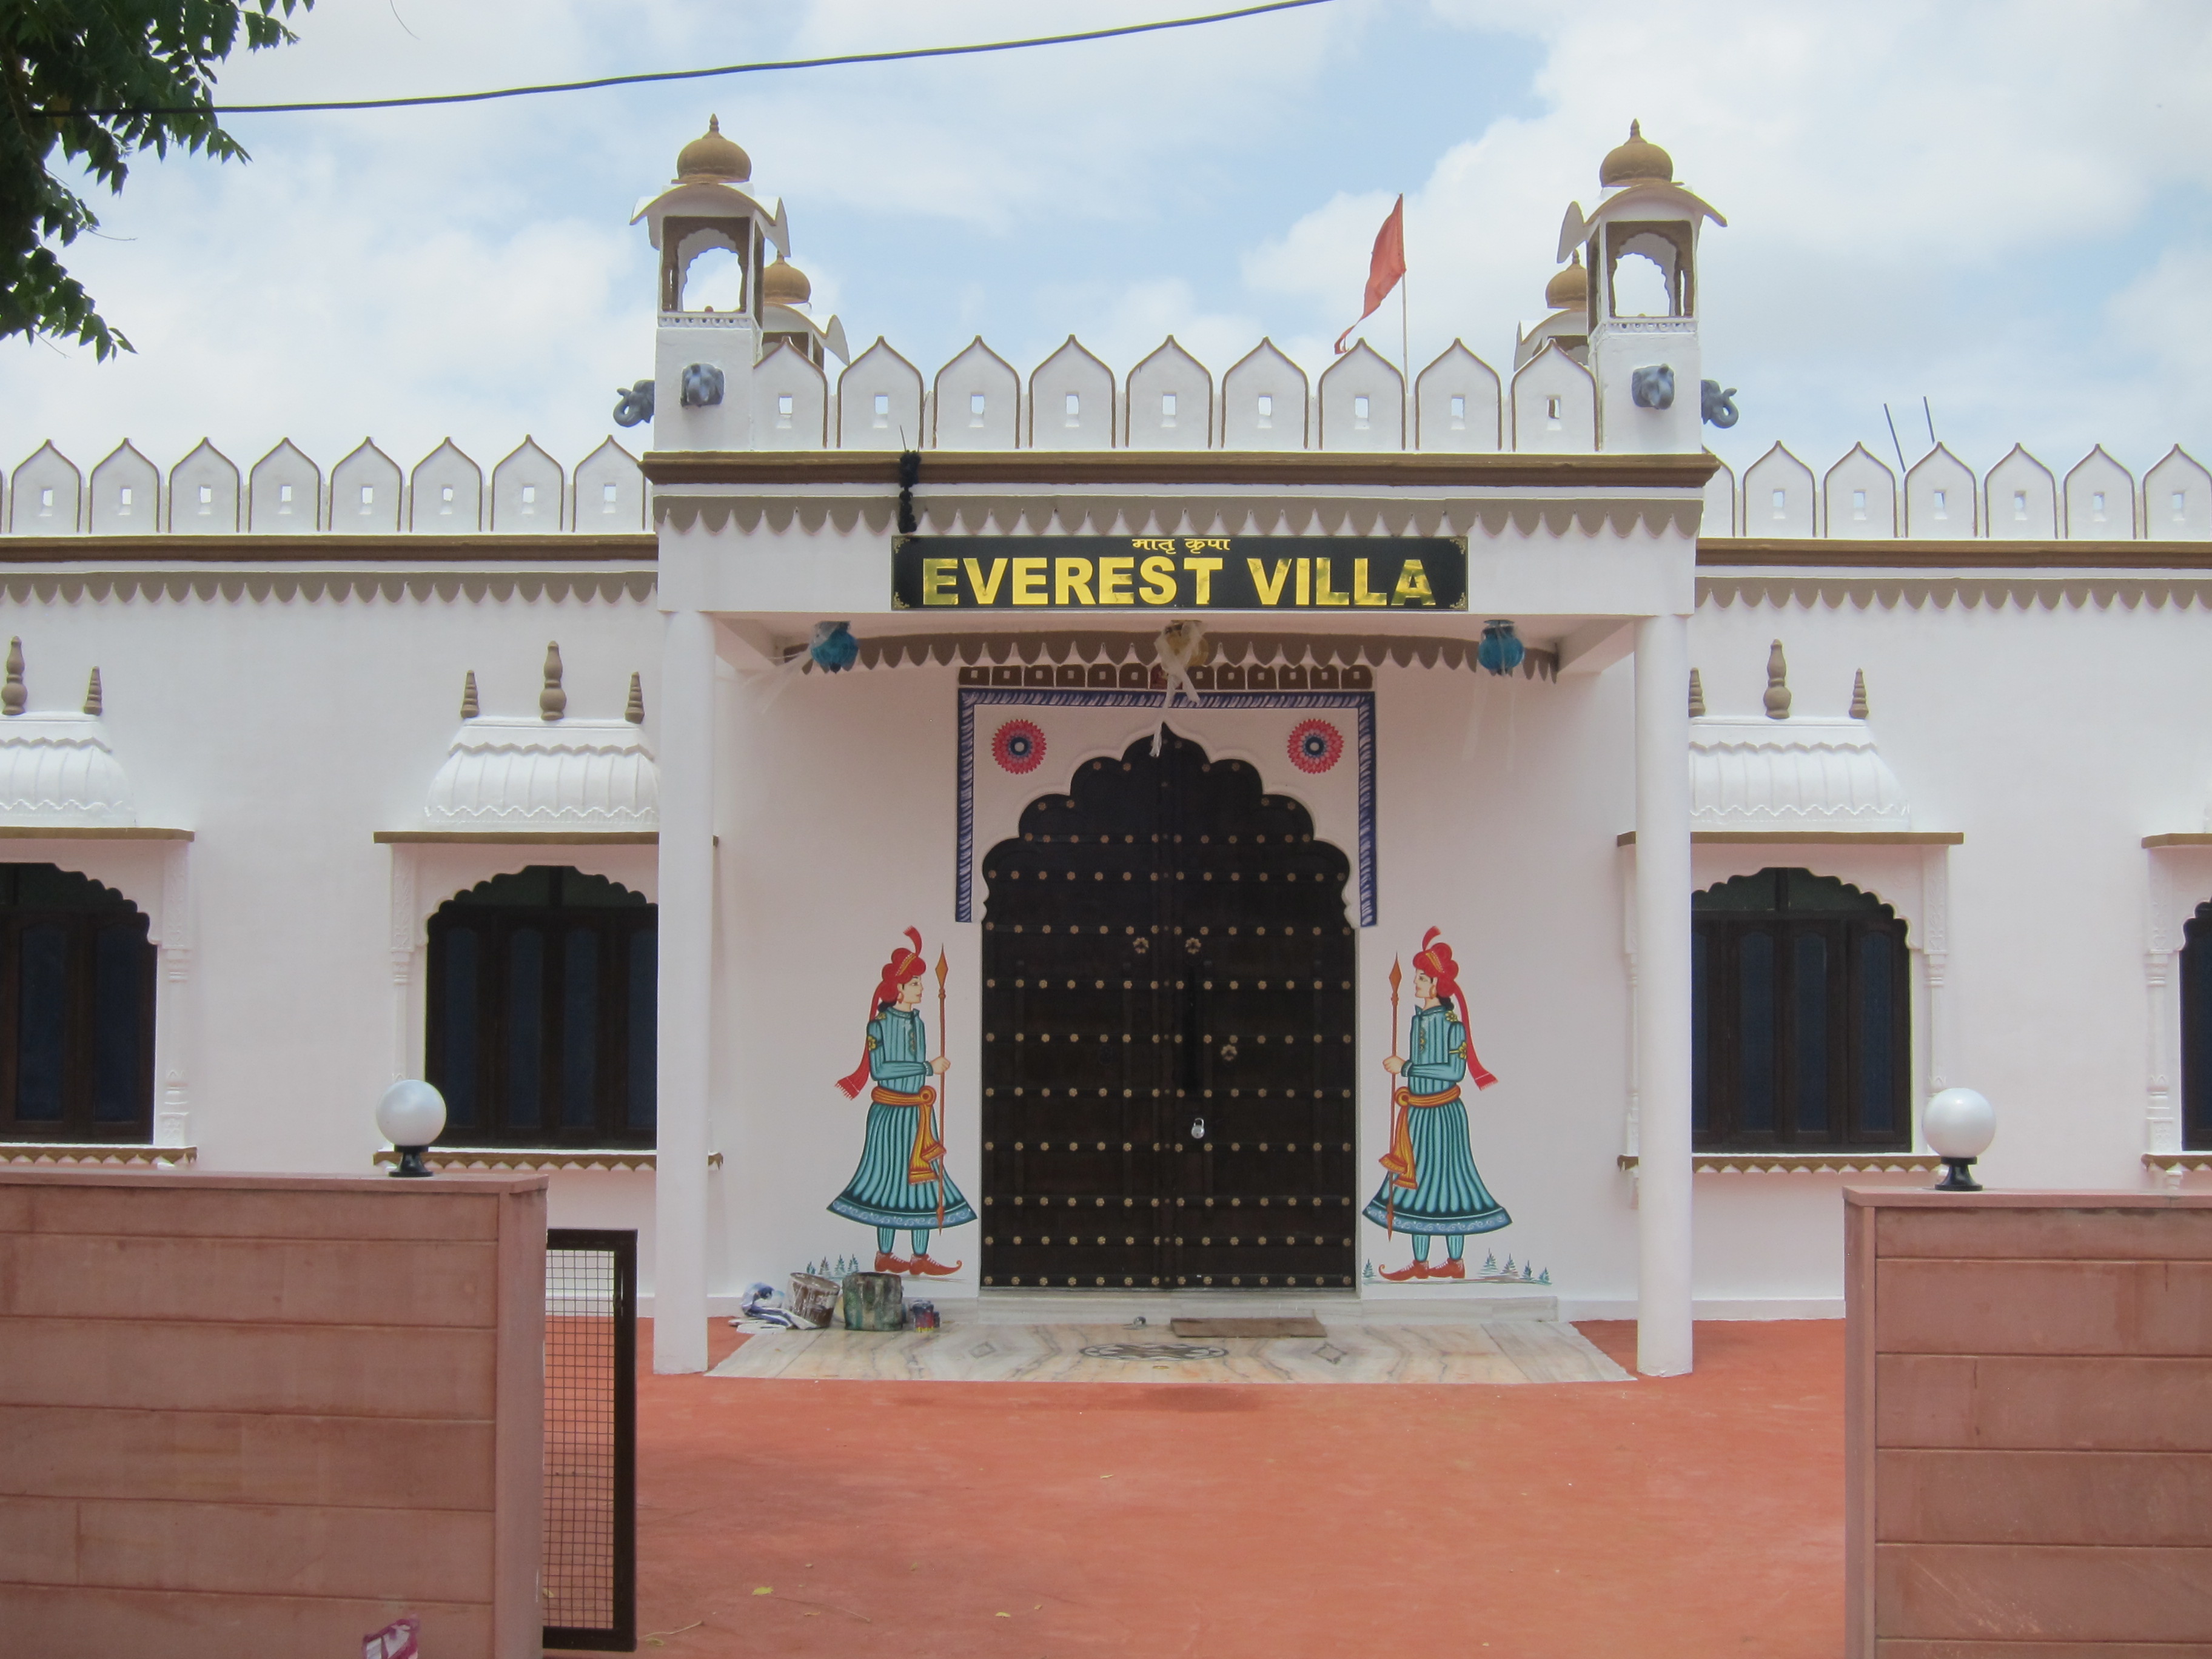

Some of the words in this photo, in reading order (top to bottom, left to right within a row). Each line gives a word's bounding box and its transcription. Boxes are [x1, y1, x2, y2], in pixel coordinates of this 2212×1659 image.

[1131, 538, 1176, 554] मातृ
[1184, 538, 1231, 554] कृपा
[922, 555, 1224, 606] EVEREST
[1247, 557, 1436, 606] VILLA
